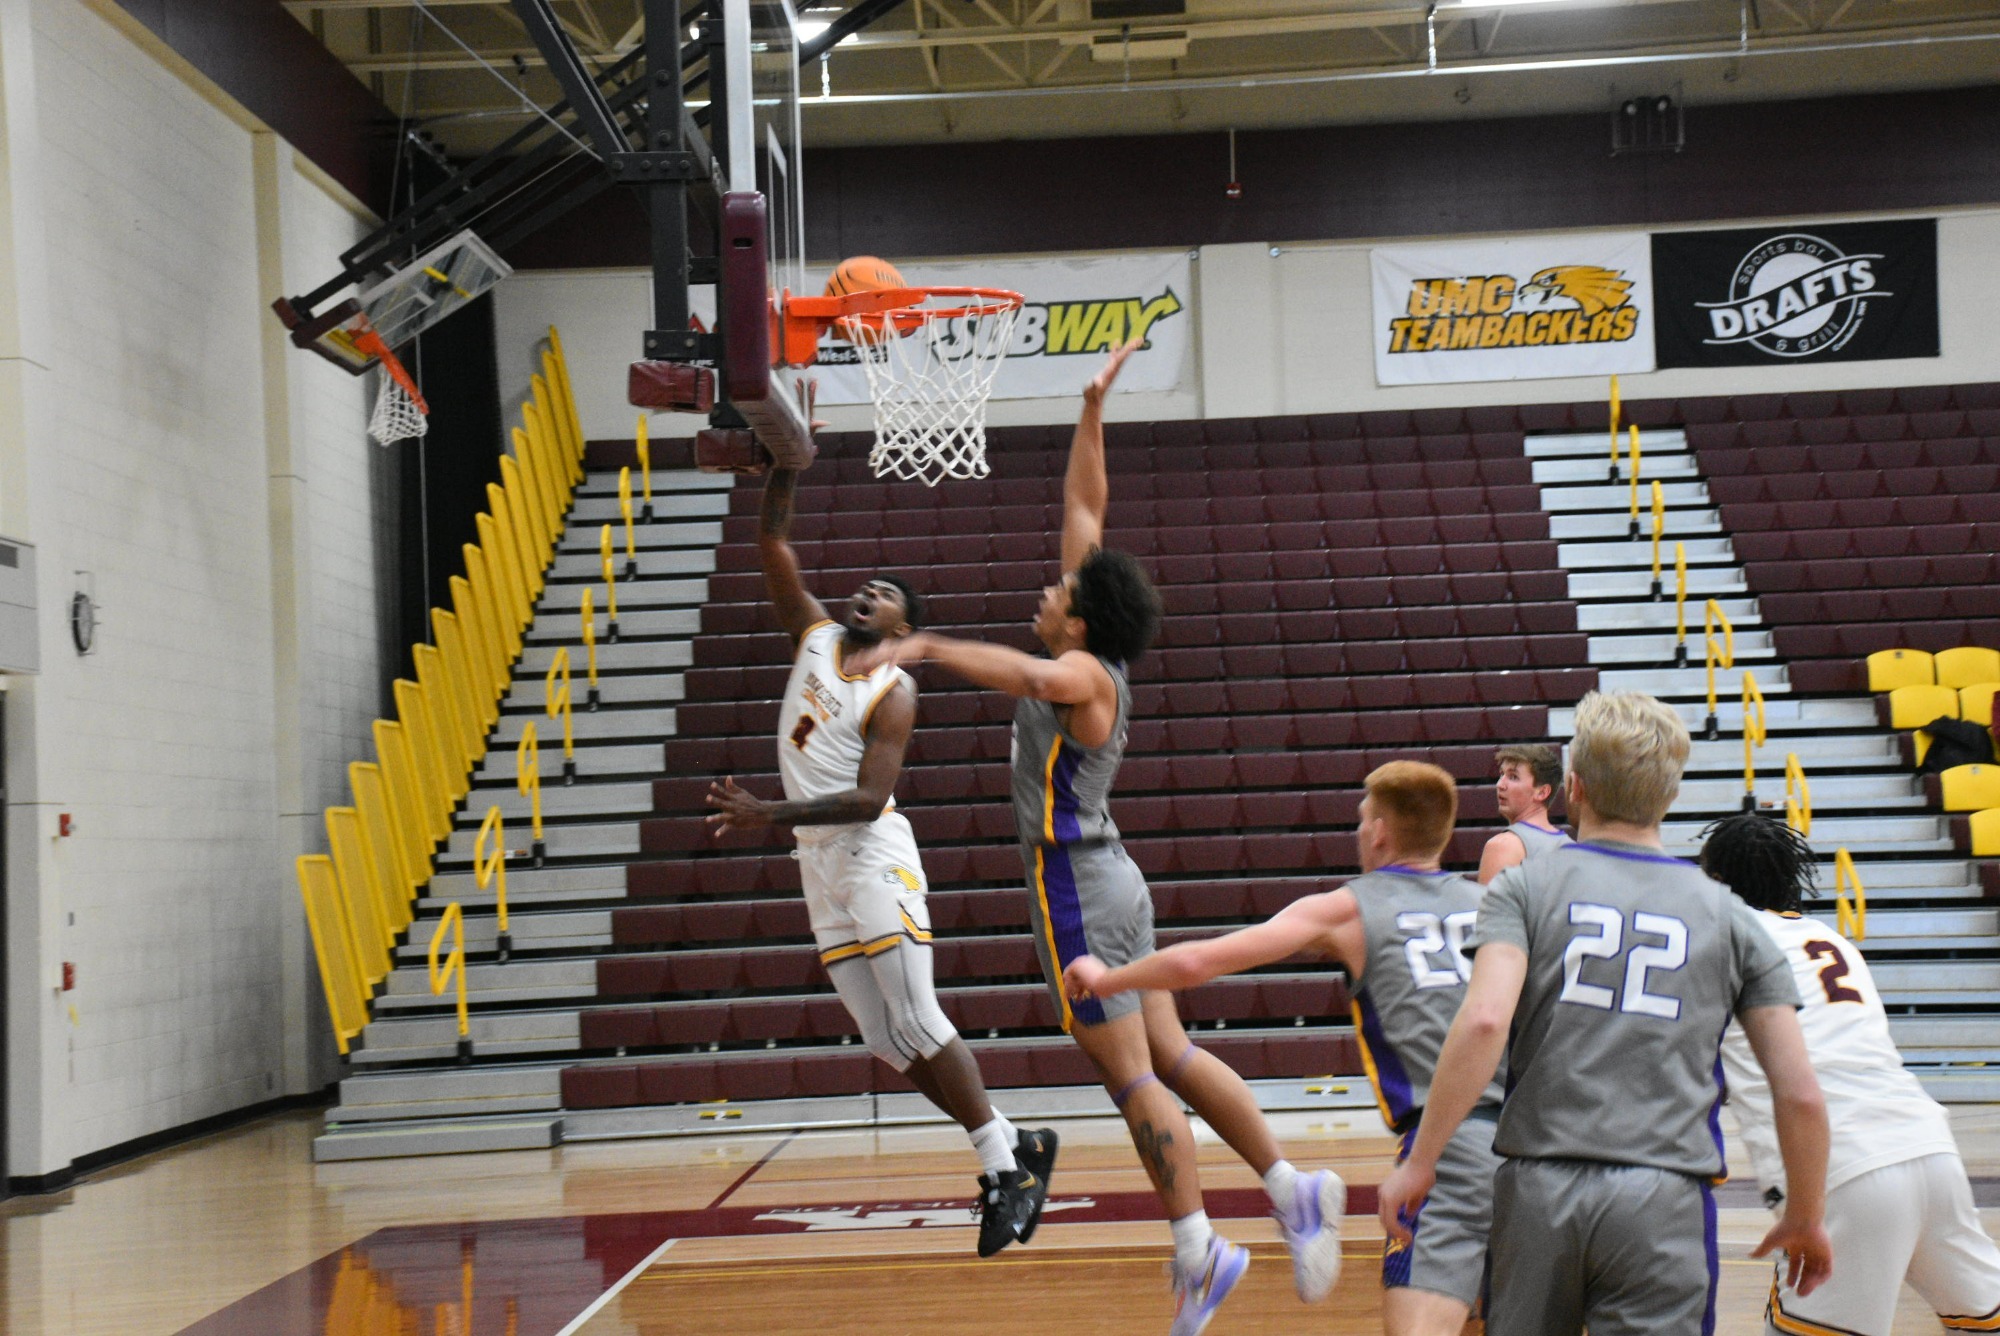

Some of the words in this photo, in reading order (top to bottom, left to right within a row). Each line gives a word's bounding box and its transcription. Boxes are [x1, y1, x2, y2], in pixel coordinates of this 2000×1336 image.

[1388, 304, 1641, 354] TEAMBACKERS
[1407, 275, 1516, 318] UMC
[1709, 259, 1876, 339] DRAFTS
[1559, 901, 1689, 1020] 22
[1803, 938, 1864, 1005] 2
